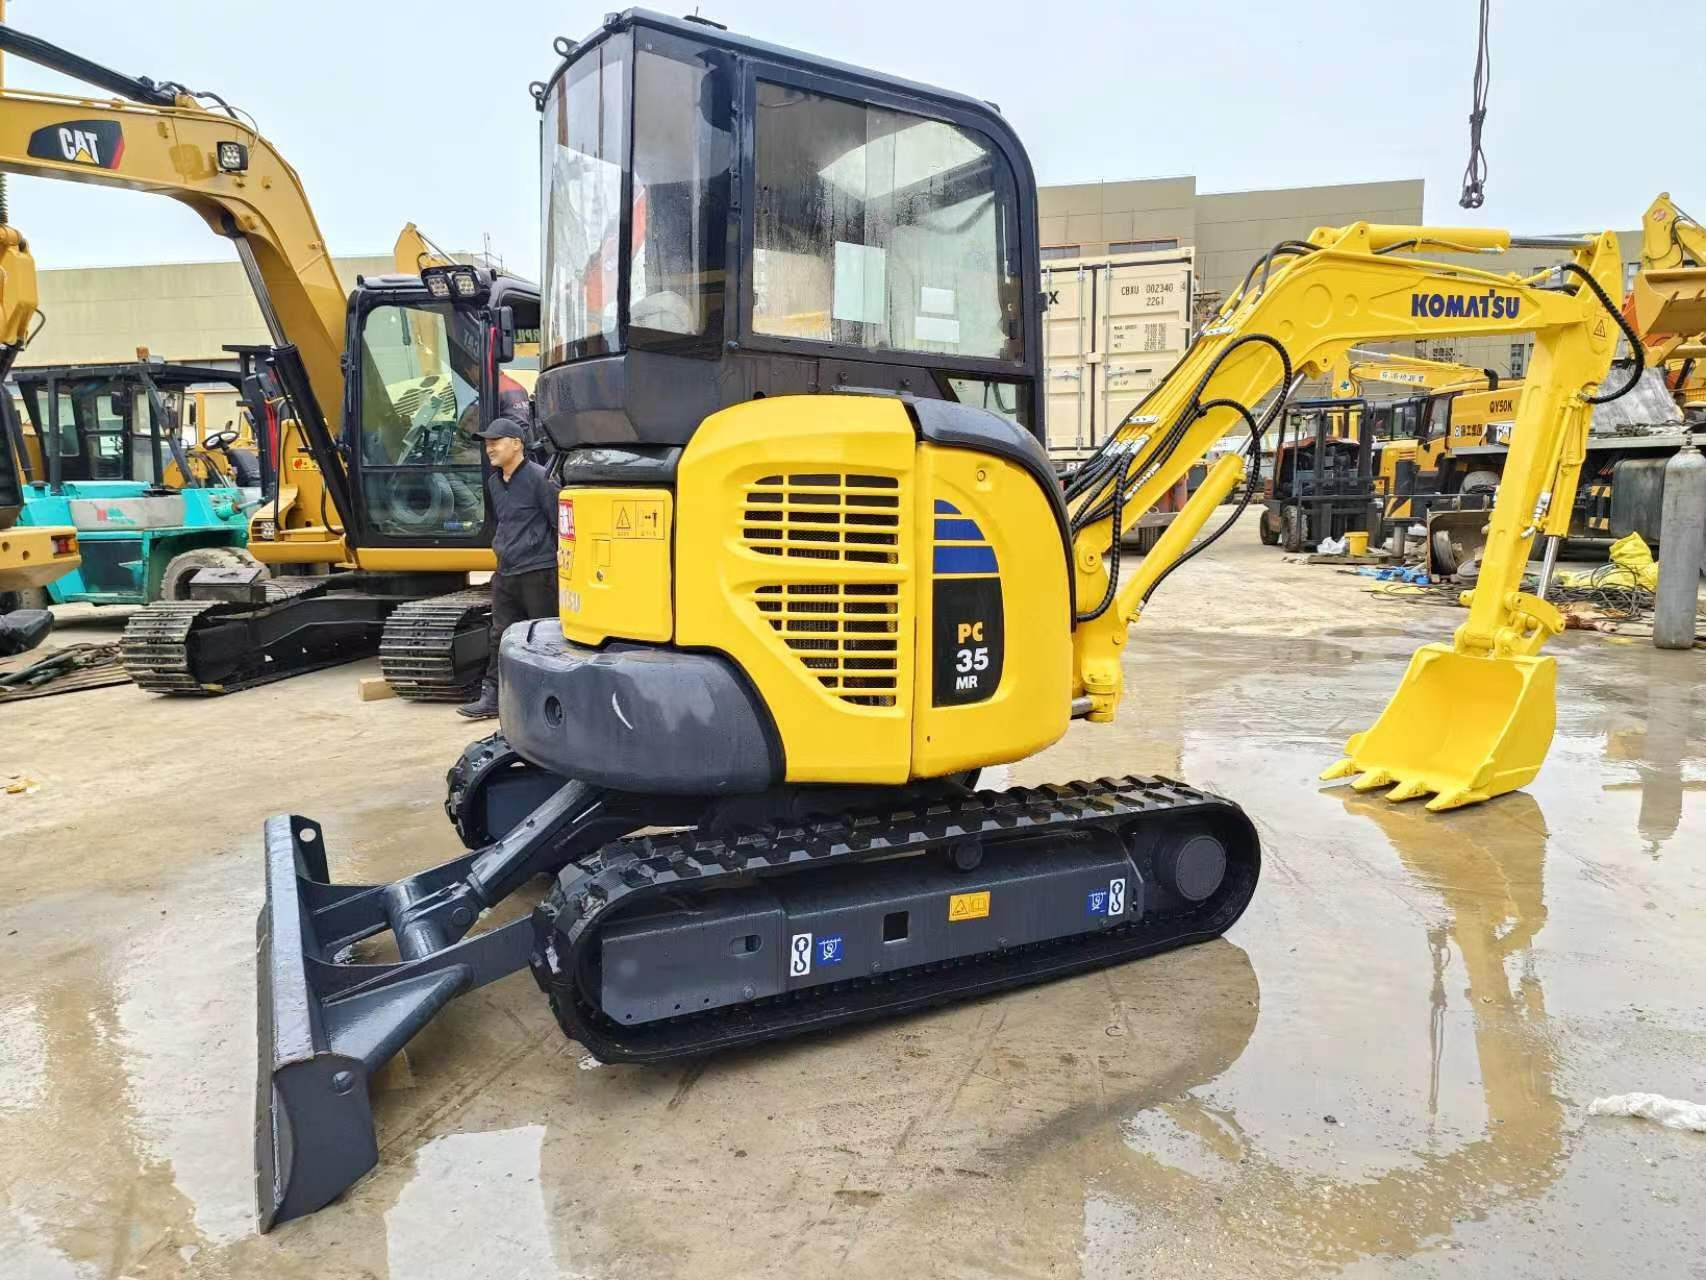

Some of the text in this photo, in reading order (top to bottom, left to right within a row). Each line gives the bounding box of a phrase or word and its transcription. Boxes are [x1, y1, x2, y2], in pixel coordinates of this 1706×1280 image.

[59, 127, 100, 164] CAT
[1048, 290, 1059, 305] X
[1121, 286, 1140, 296] CBXU
[1146, 283, 1174, 294] 002340
[1411, 289, 1520, 319] KOMATSU
[1489, 400, 1513, 413] QY50K
[957, 621, 984, 644] PC
[955, 647, 989, 673] 35
[955, 675, 978, 690] MR
